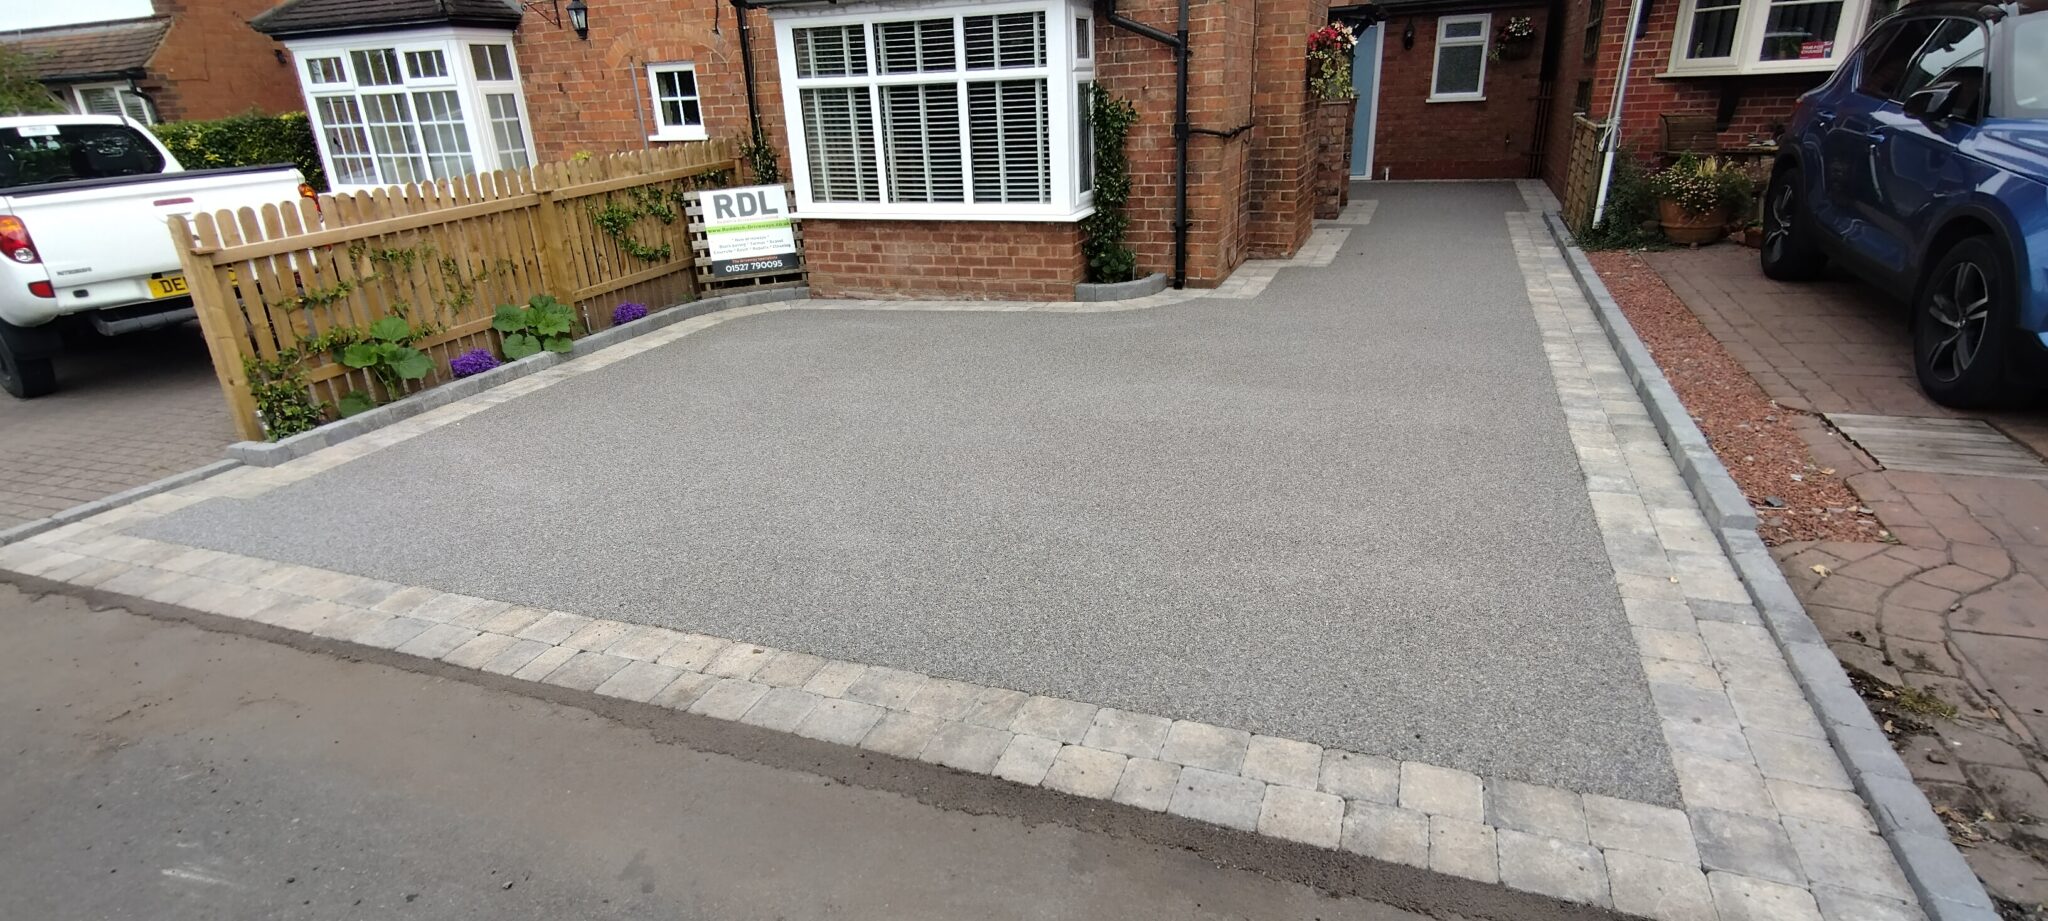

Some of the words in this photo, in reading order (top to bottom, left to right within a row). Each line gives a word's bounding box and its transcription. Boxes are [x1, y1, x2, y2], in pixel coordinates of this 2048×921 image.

[713, 191, 778, 219] RDL
[725, 263, 748, 272] 01527
[751, 260, 783, 270] 790095
